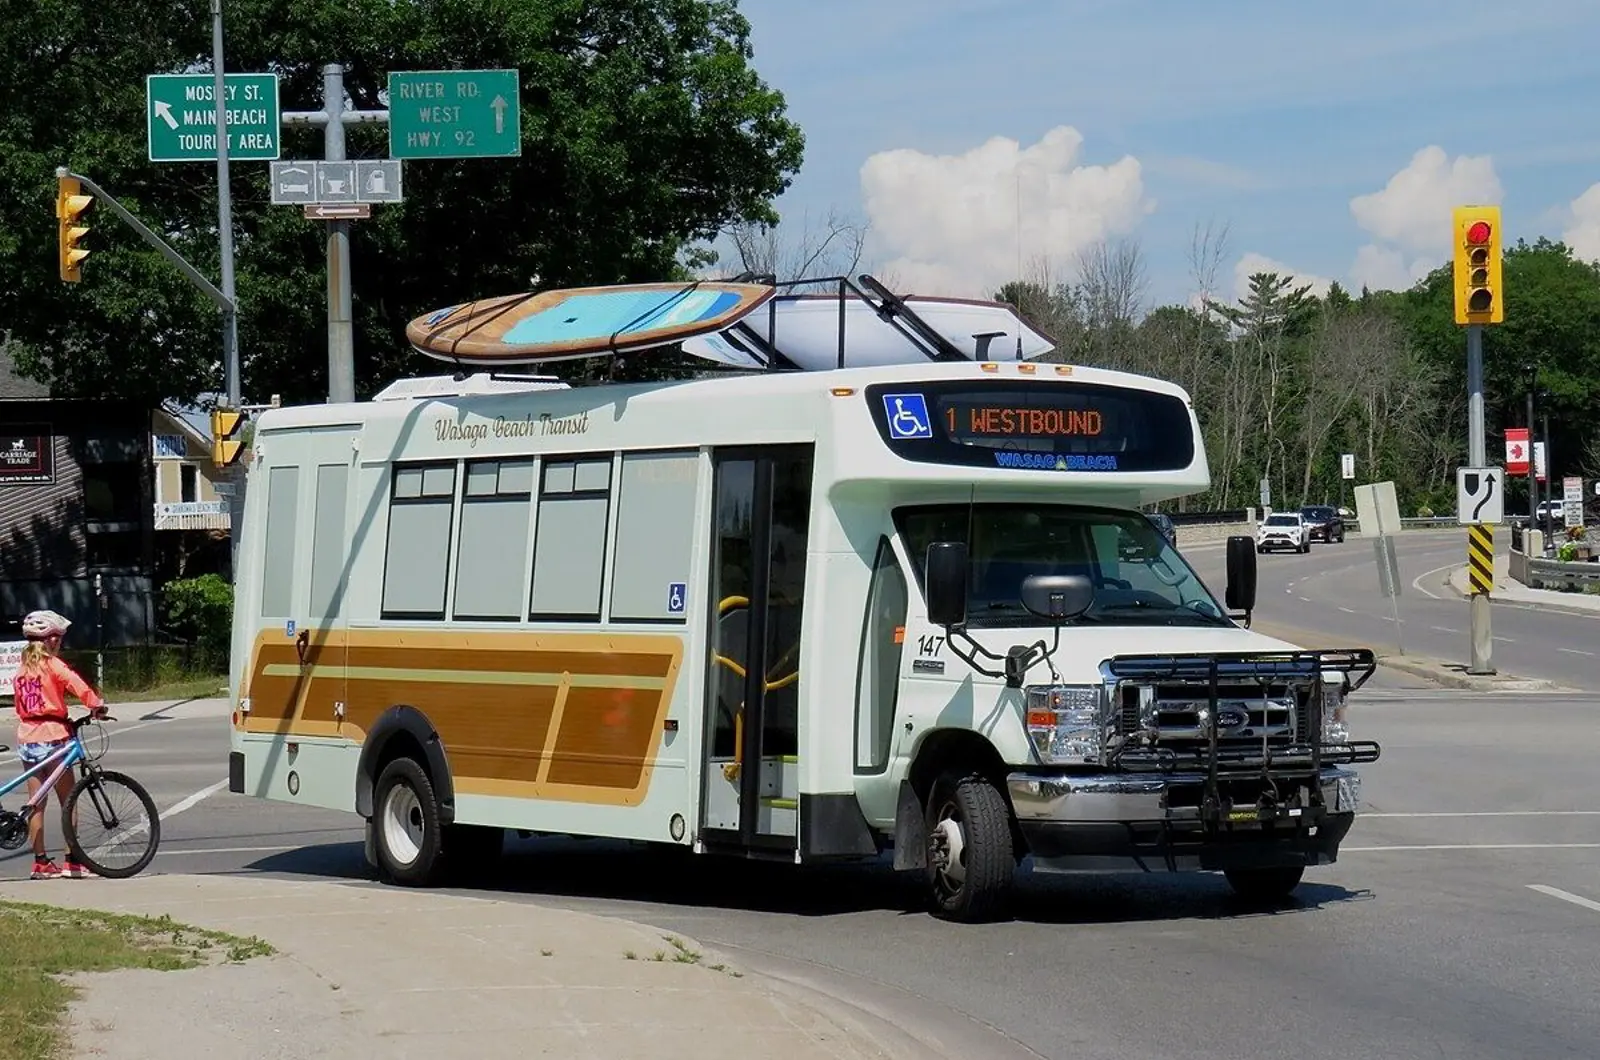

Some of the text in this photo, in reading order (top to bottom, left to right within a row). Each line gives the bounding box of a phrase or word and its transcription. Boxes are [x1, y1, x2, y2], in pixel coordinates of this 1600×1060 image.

[244, 85, 264, 100] ST.
[400, 82, 481, 98] RIVER RD.
[183, 109, 267, 125] MAIN BEACH
[419, 106, 461, 123] WEST
[178, 134, 273, 150] TOURIT AREA
[407, 130, 475, 148] HWY. 92
[946, 407, 1101, 435] 1 WESTBOUND
[434, 410, 589, 449] Wasaga Beach Transit
[0, 451, 37, 459] CARRIAGE
[7, 457, 31, 465] TRADE
[918, 634, 945, 657] 147
